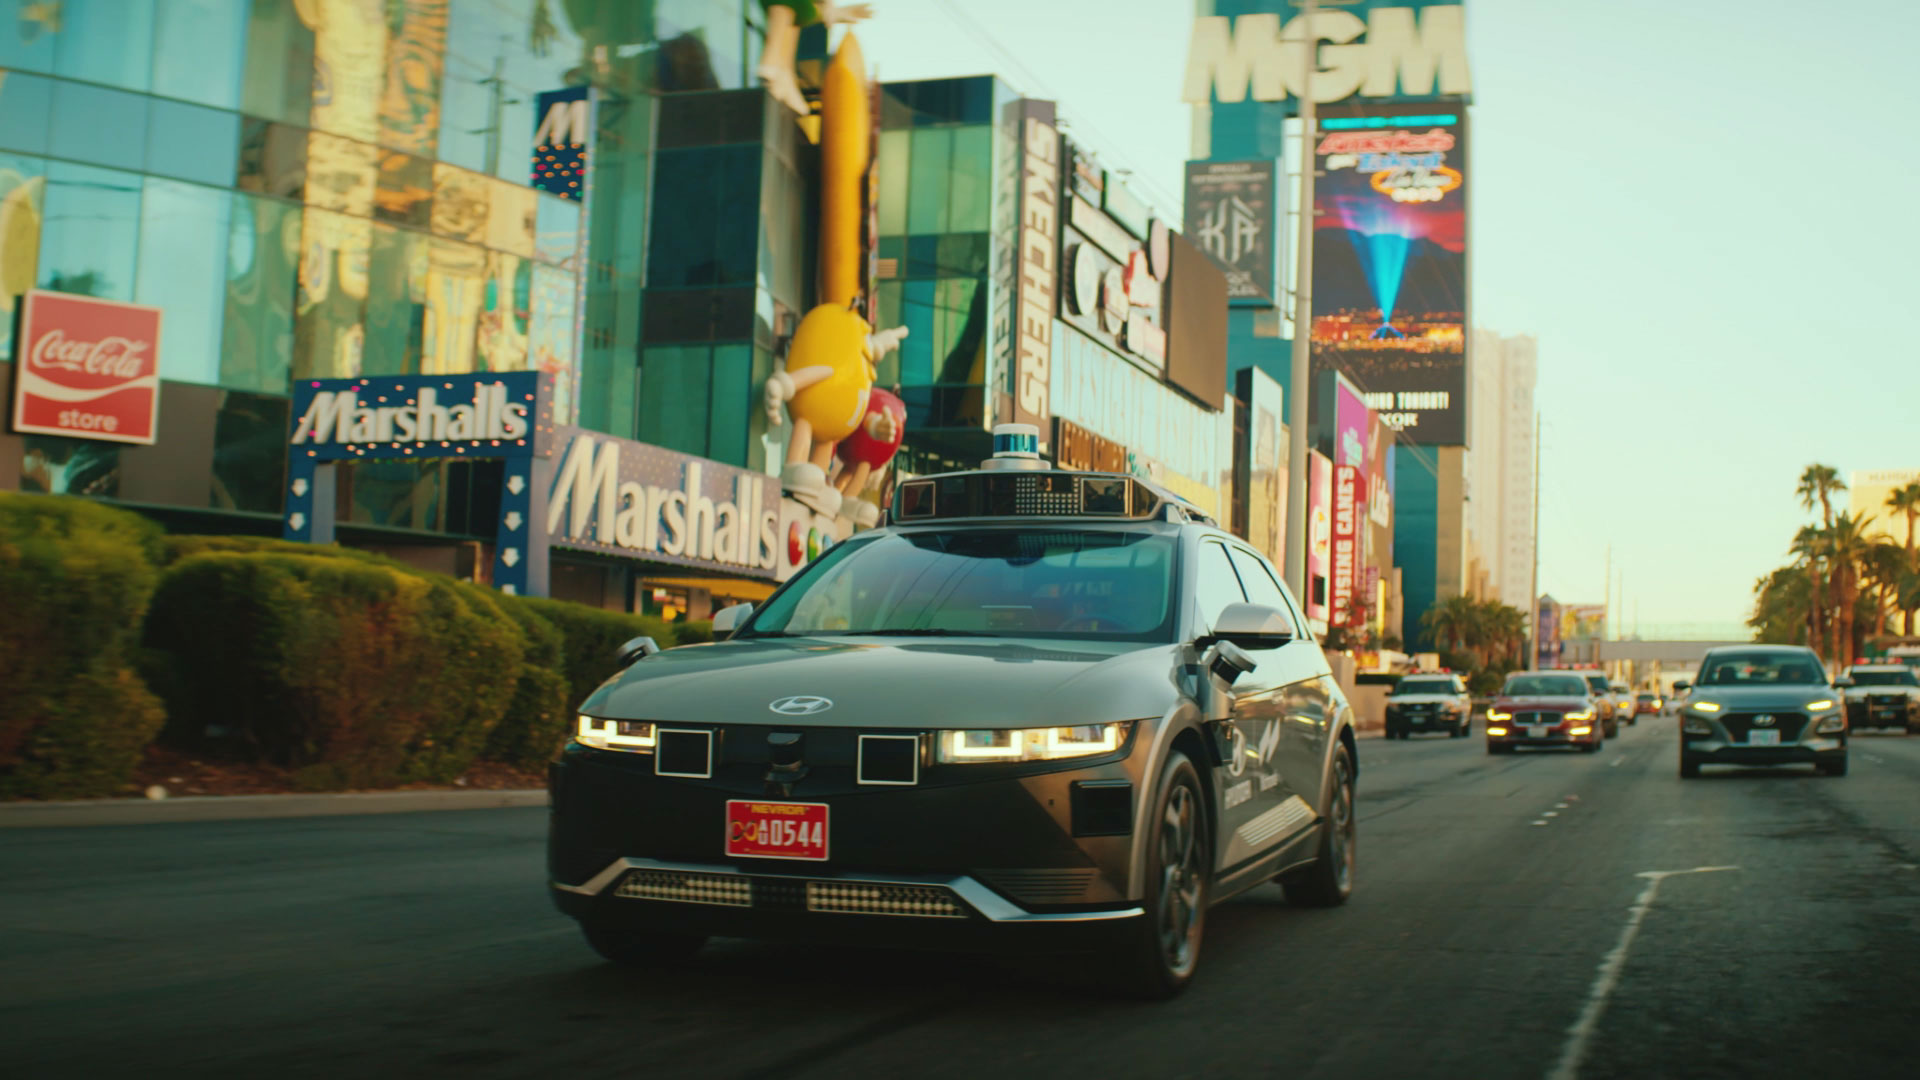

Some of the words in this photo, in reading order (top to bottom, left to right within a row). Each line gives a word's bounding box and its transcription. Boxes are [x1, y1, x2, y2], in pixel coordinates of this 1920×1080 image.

[1183, 5, 1471, 103] MGM
[534, 100, 588, 147] M
[1019, 116, 1055, 421] SKECHERS
[58, 409, 118, 432] store
[291, 384, 528, 444] Marshalls
[547, 434, 778, 570] Marshalls
